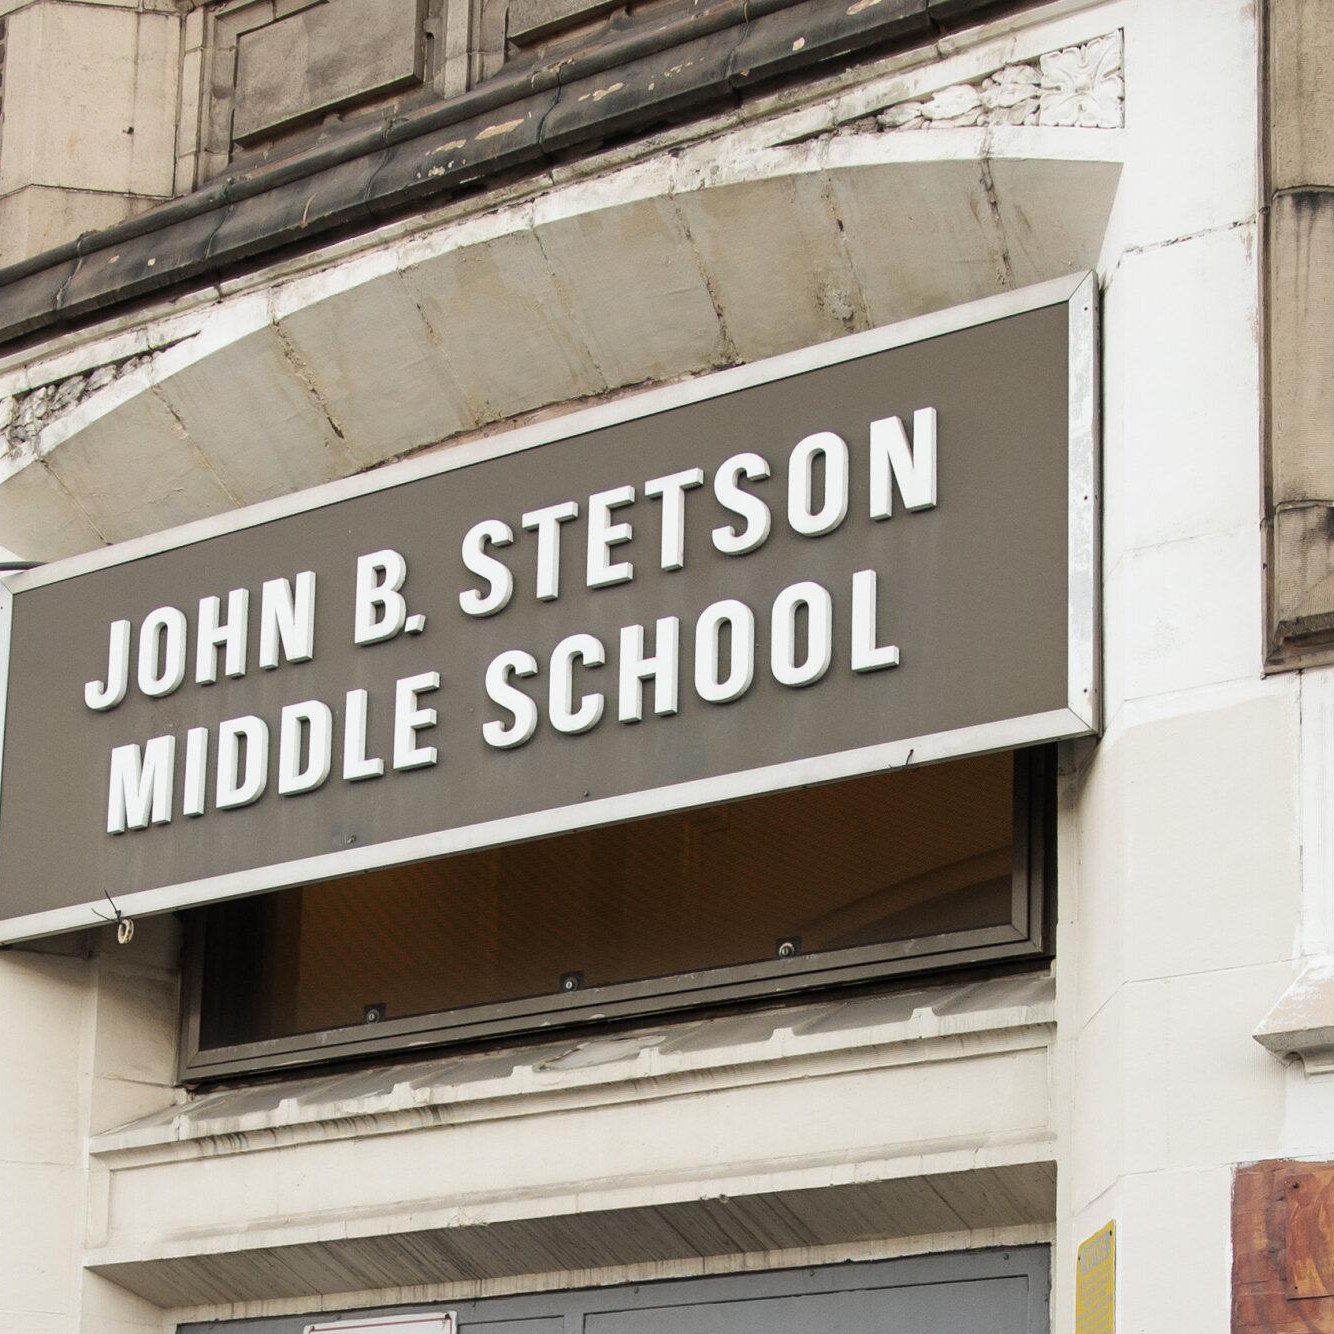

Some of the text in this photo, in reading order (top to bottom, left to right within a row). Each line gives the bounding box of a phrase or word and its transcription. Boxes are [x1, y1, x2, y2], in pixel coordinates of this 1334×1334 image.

[85, 407, 937, 710] JOHN B. STETSON
[107, 569, 900, 833] MIDDLE SCHOOL
